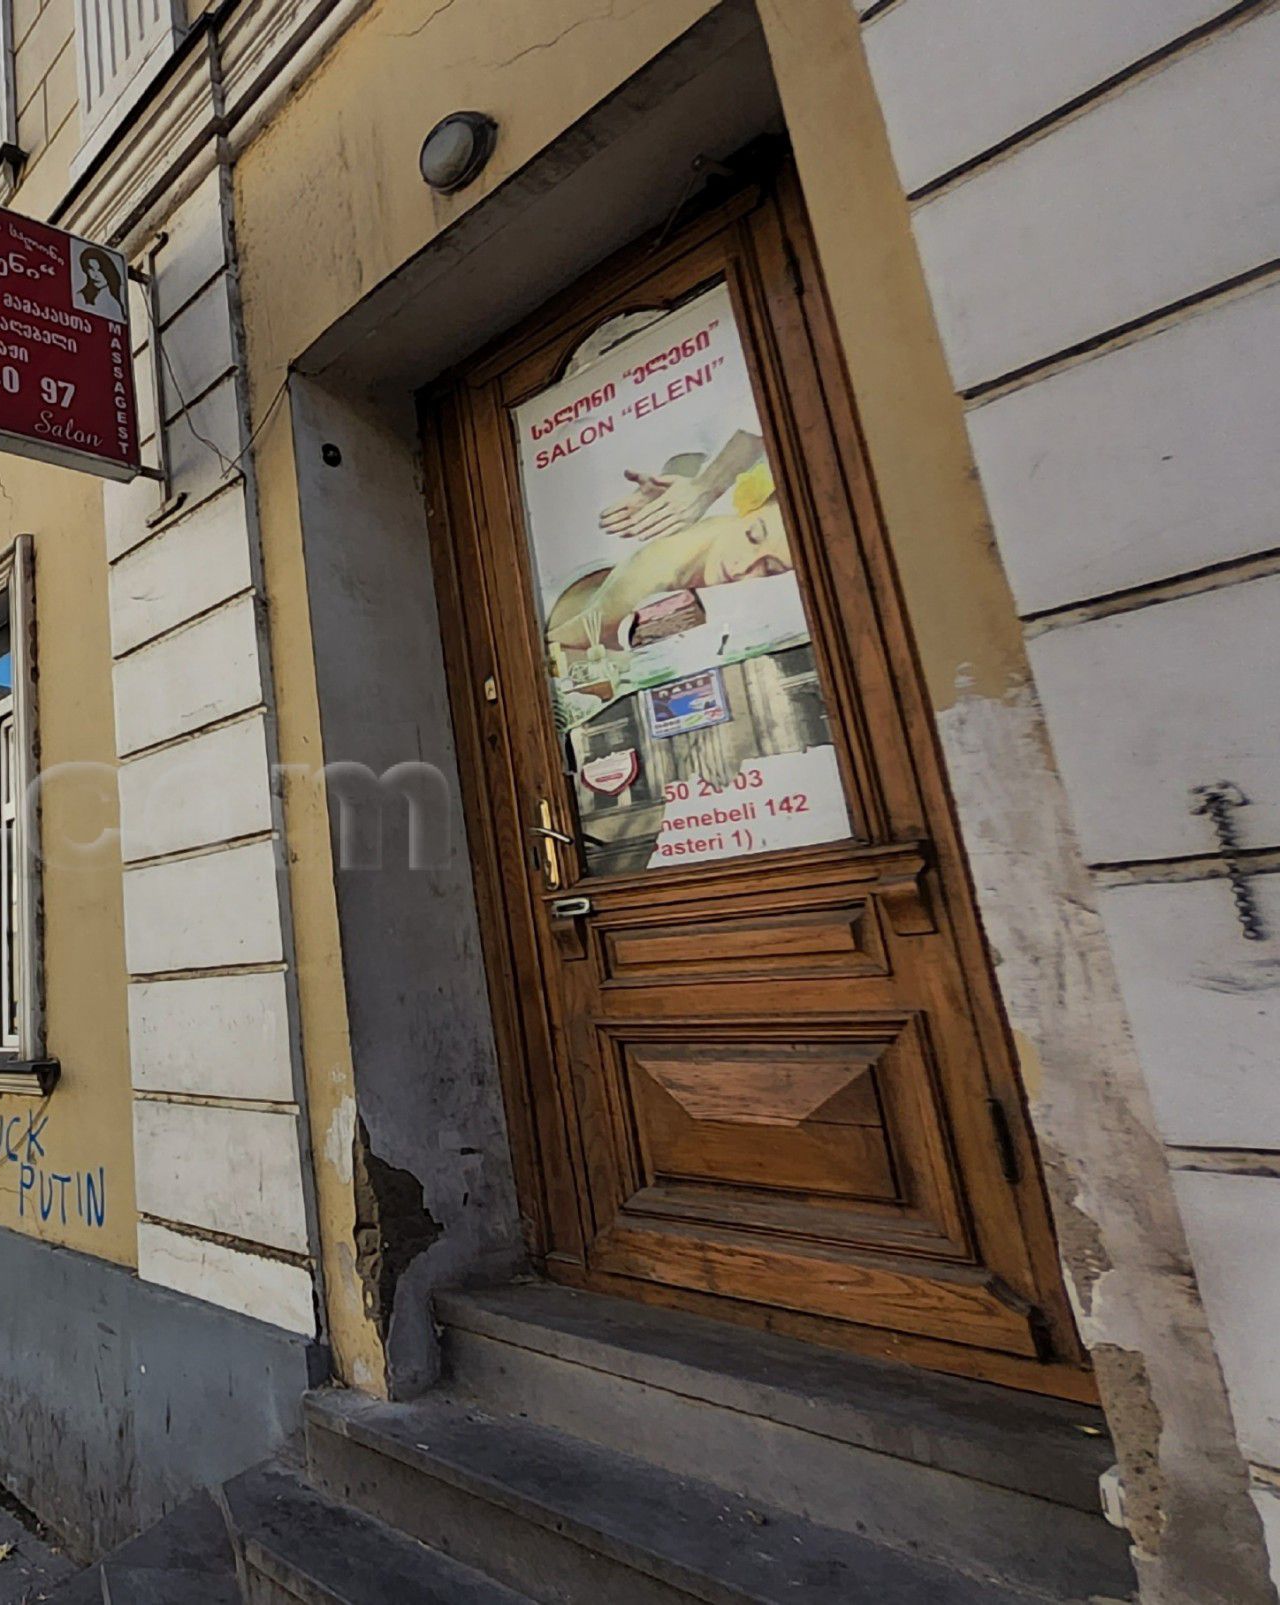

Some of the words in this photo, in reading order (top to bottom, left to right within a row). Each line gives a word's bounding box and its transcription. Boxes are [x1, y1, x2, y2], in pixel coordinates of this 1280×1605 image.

[40, 376, 76, 409] 97
[530, 382, 616, 441] სალონი
[34, 410, 104, 448] Salon
[535, 415, 615, 470] SALON
[765, 794, 809, 817] 142
[19, 1162, 106, 1228] PUTIN
